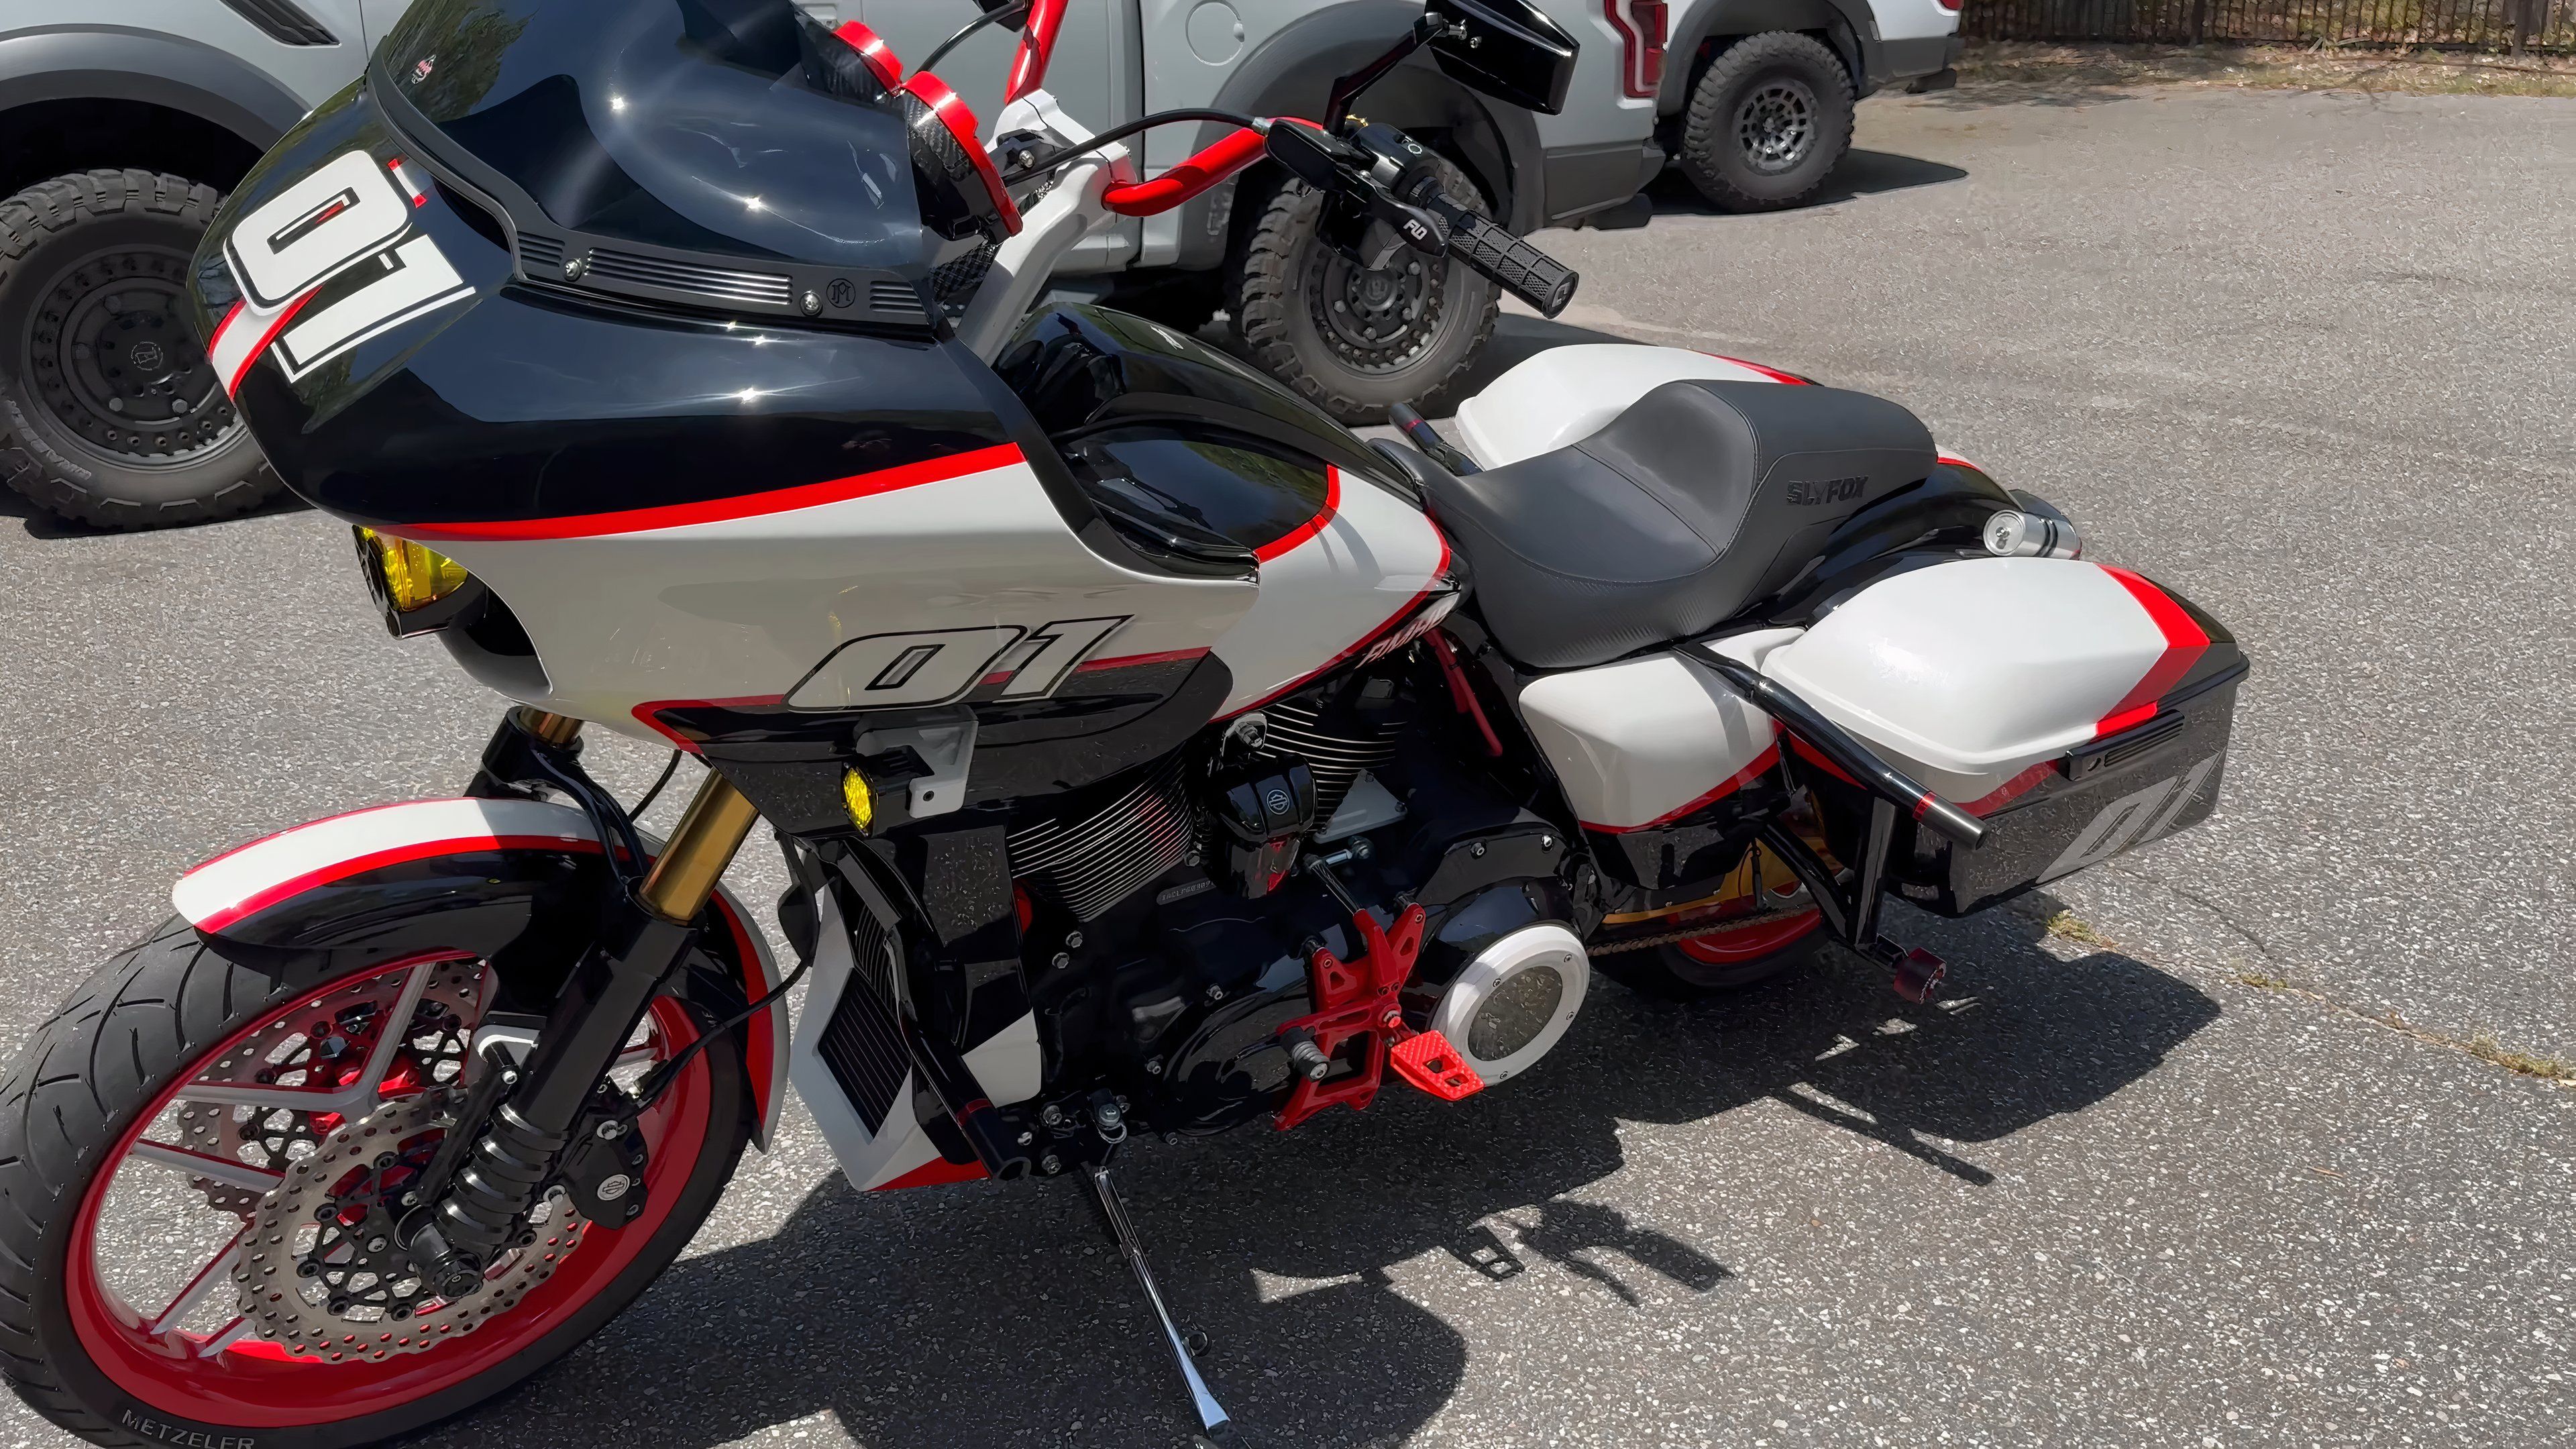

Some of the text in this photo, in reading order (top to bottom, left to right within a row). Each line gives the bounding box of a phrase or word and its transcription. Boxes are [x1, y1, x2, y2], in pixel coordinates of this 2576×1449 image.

[223, 150, 476, 383] 01
[1786, 476, 1869, 506] SLYFOX
[787, 614, 1135, 713] 01
[121, 1409, 255, 1449] METZELER
